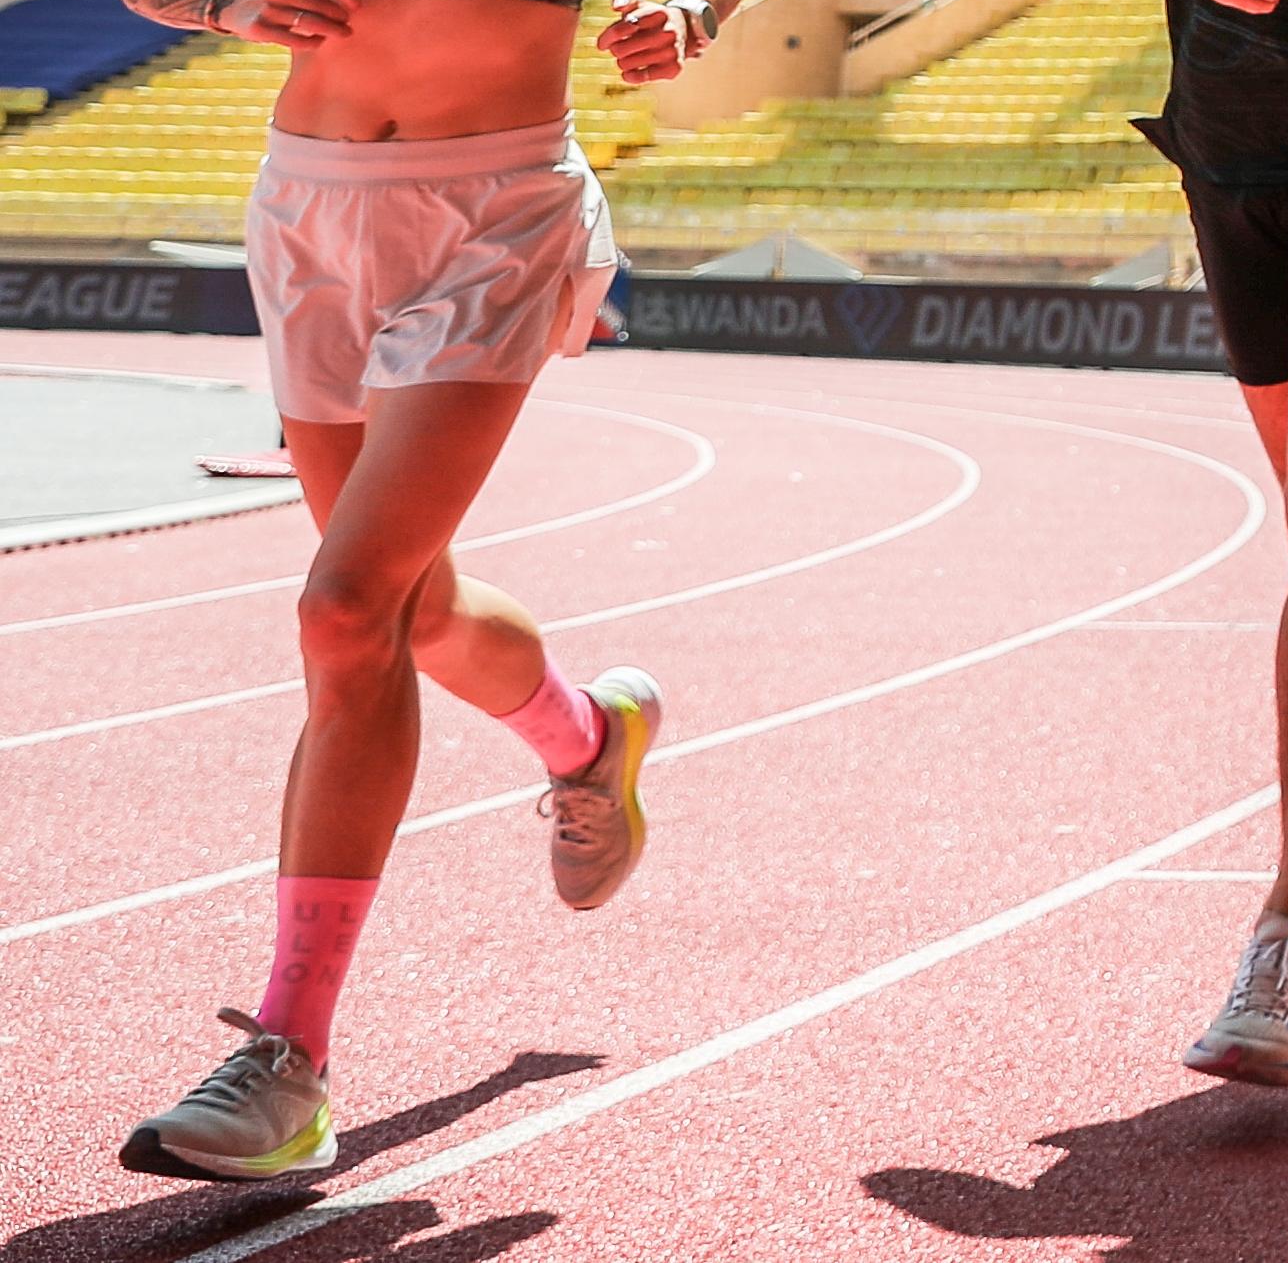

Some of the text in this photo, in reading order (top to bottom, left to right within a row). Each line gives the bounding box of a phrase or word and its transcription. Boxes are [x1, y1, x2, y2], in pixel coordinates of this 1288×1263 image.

[679, 292, 829, 338] WANDA
[911, 294, 1223, 359] DIAMOND LE
